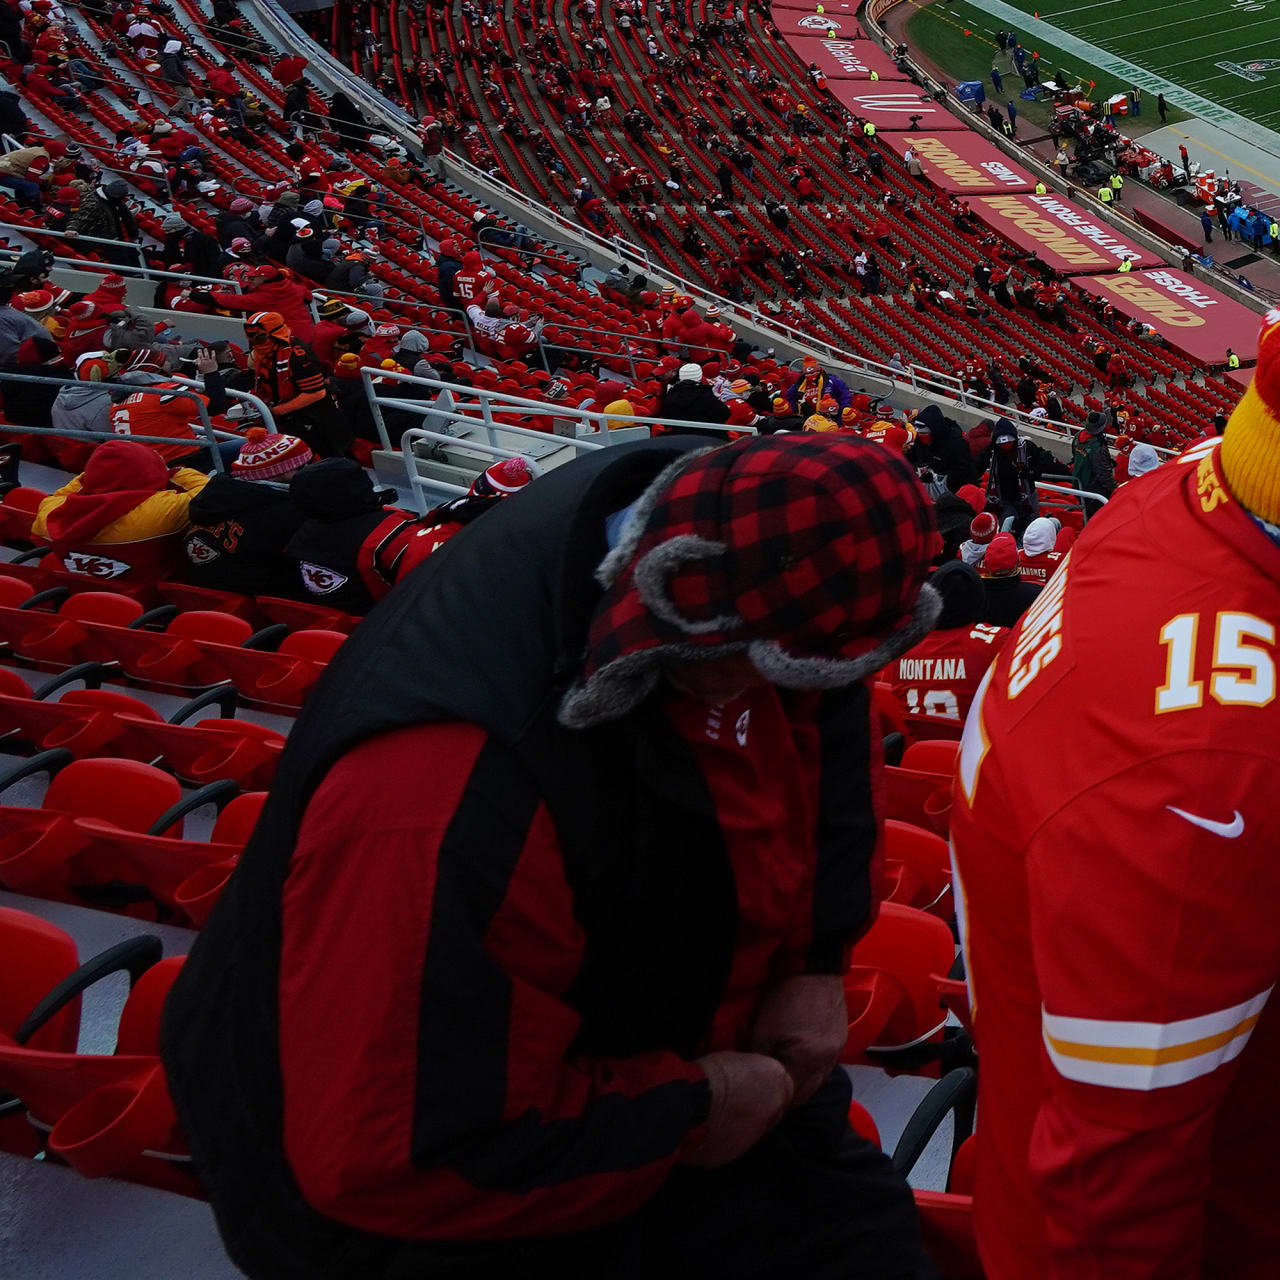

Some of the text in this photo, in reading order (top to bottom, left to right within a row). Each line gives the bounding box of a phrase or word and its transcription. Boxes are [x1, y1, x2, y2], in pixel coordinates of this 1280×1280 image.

[1104, 61, 1235, 122] INSPIRE CHANGE
[903, 137, 996, 186] HONORS
[980, 161, 1027, 186] LINES
[1028, 195, 1090, 226] FRONT
[980, 196, 1110, 264] KINGDOM
[1073, 225, 1117, 246] THE
[458, 283, 474, 299] 15
[1092, 276, 1206, 327] CHIEFS
[1143, 271, 1219, 308] THOSE
[899, 658, 966, 680] MONTANA
[1154, 610, 1276, 715] 15
